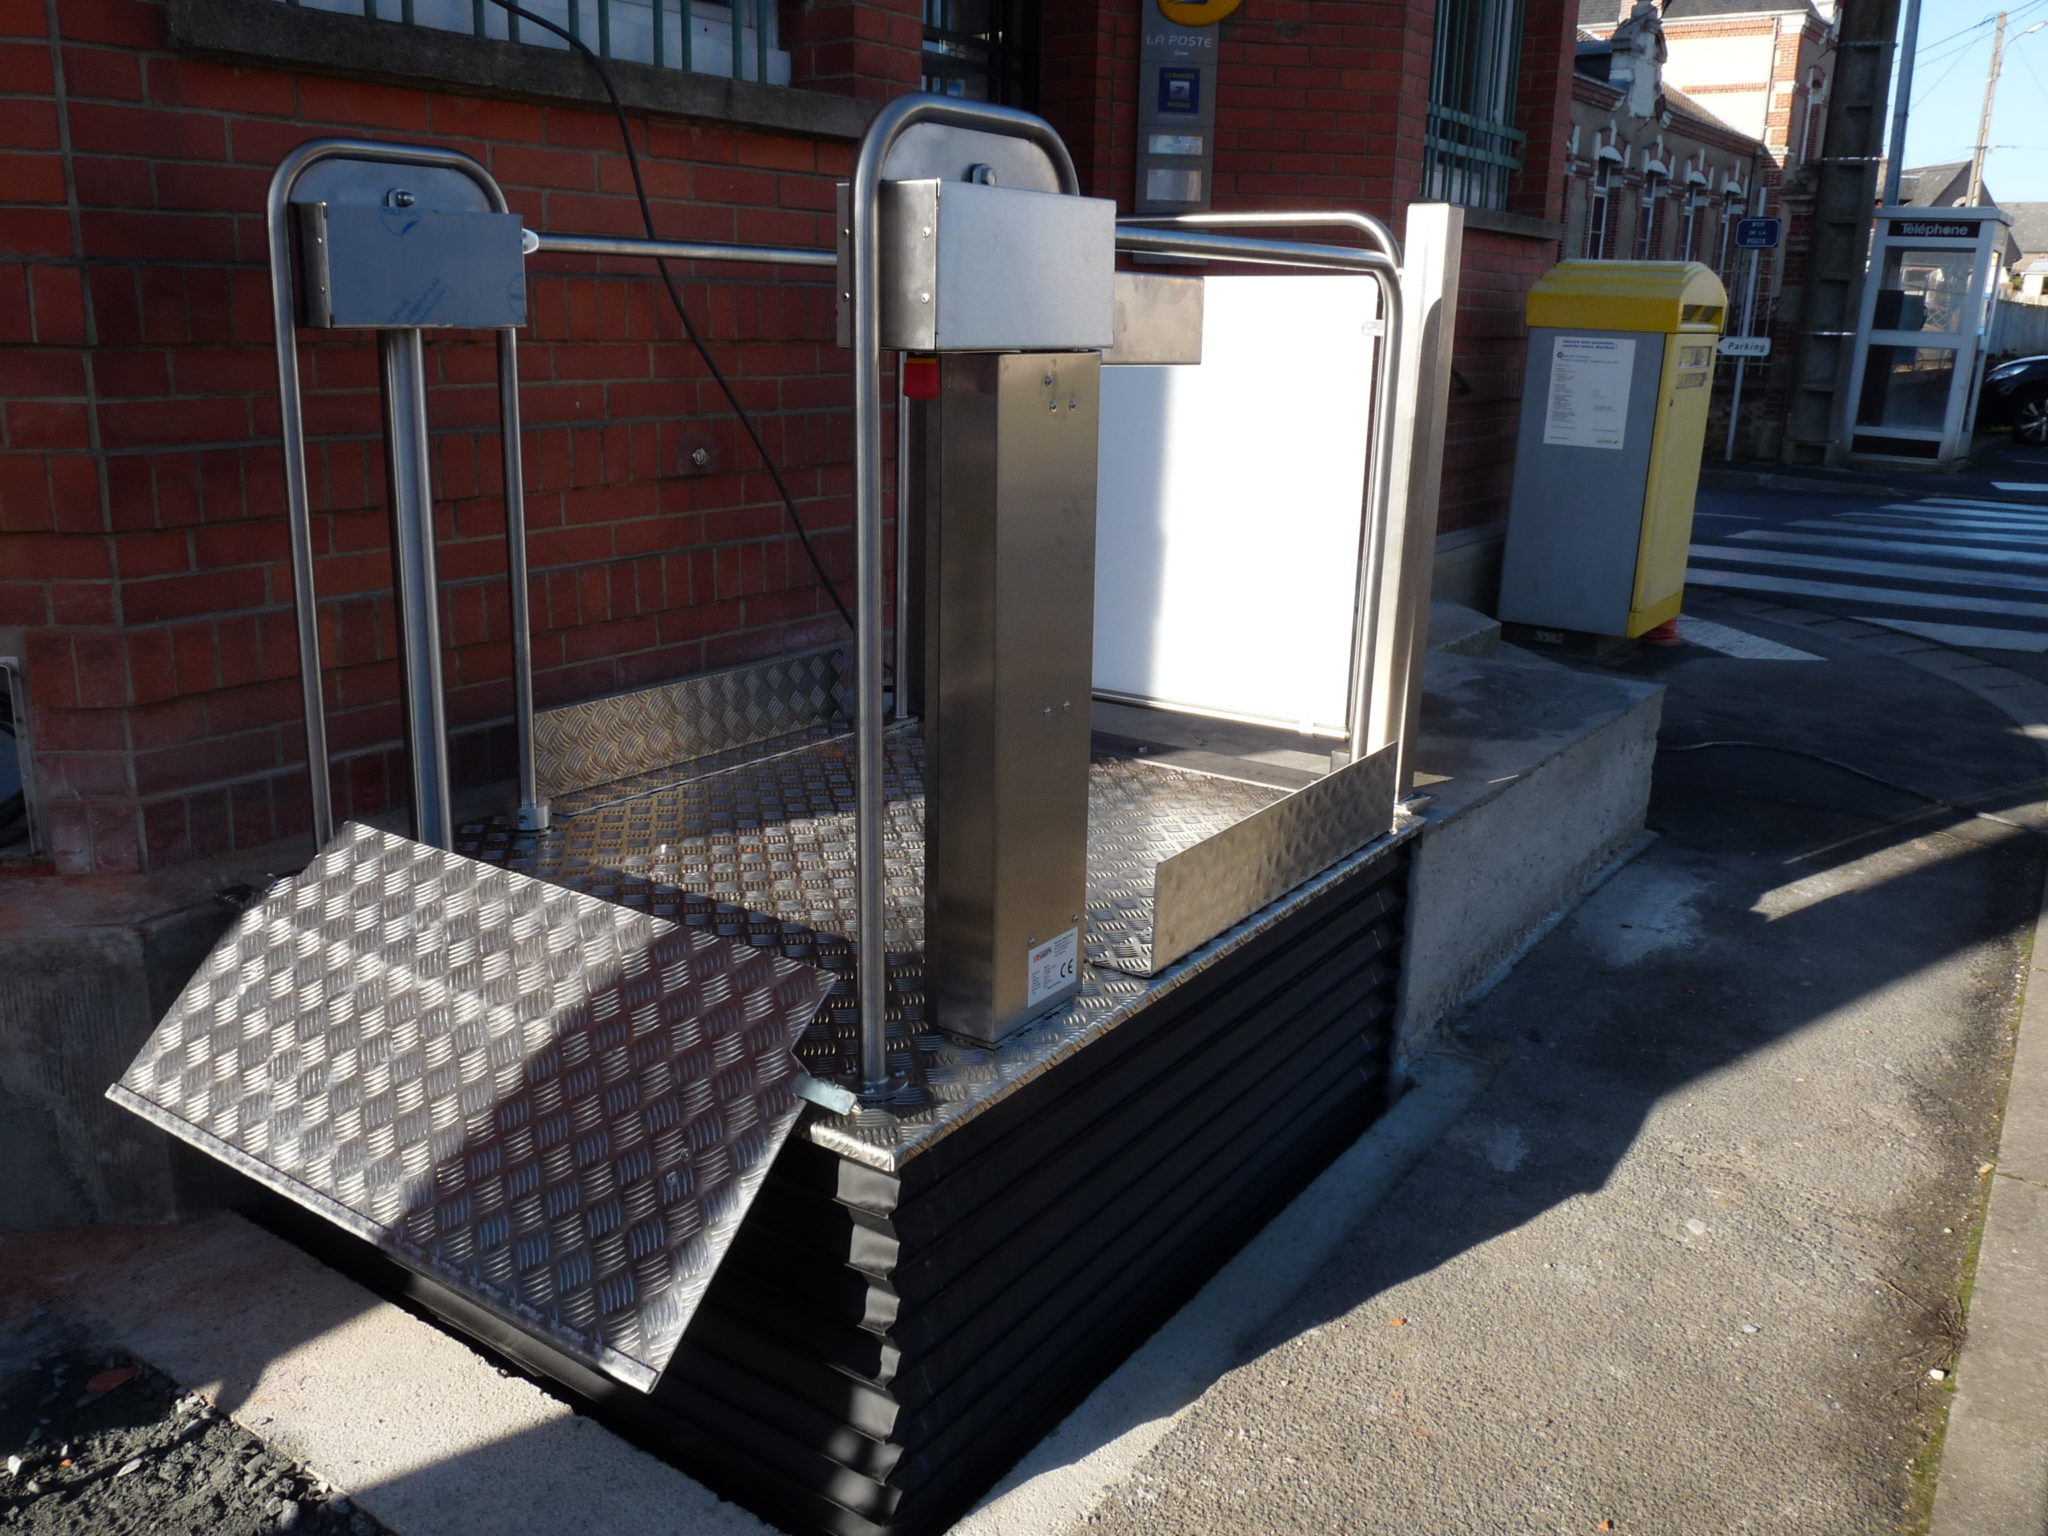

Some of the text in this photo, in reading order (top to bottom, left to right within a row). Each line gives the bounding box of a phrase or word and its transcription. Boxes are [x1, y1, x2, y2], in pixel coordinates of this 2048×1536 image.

[1146, 34, 1213, 48] LA POSTE
[1901, 223, 1969, 236] Téléphone
[1728, 341, 1766, 353] Parking
